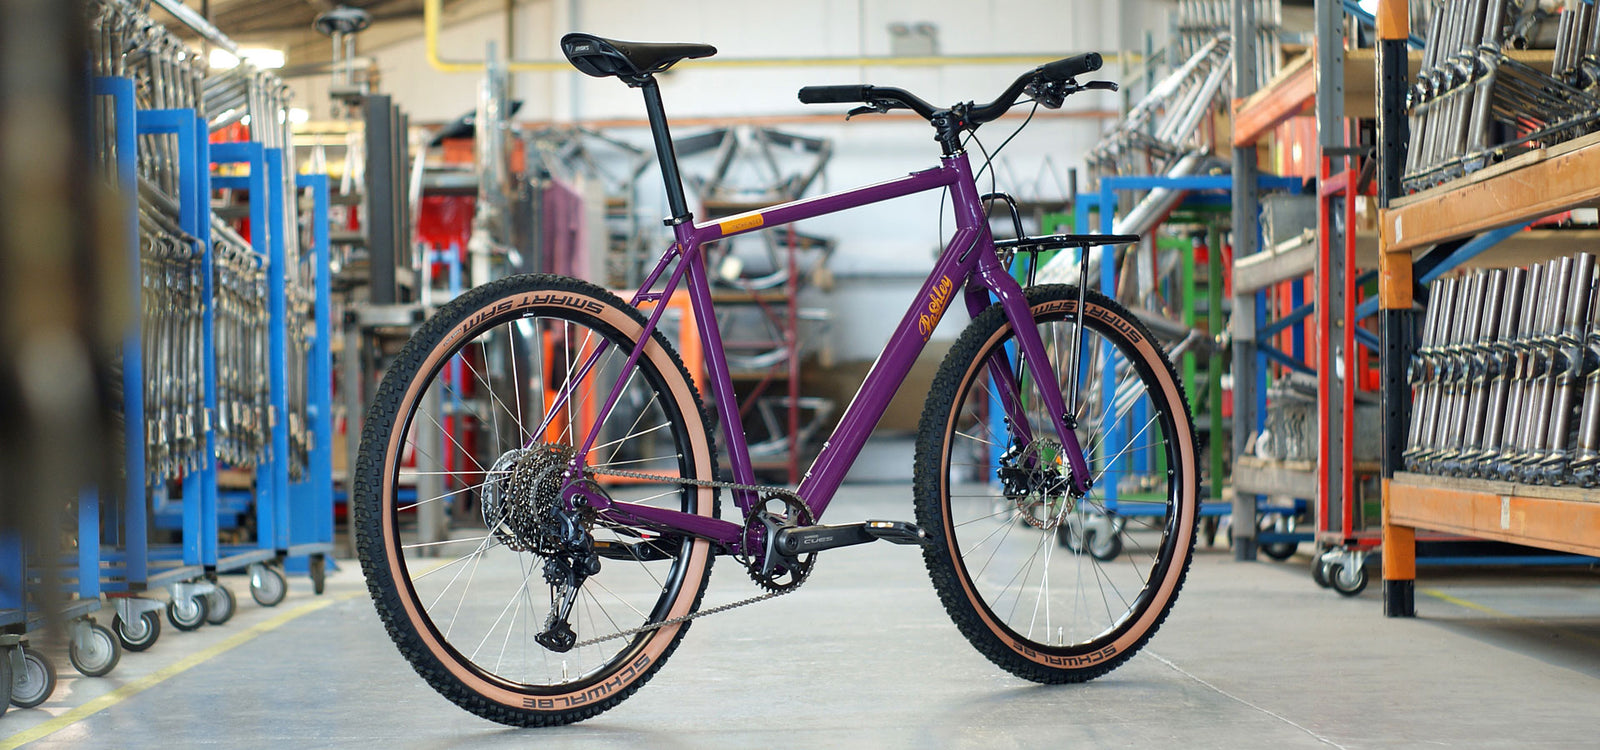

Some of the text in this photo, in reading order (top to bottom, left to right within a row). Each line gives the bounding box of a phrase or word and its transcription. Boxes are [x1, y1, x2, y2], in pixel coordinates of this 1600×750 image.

[462, 294, 605, 334] SMART SAM
[918, 275, 953, 342] Pashley
[1033, 301, 1077, 315] SAM
[1013, 640, 1117, 667] SCHWALBE
[522, 653, 651, 709] SCHWALBE
